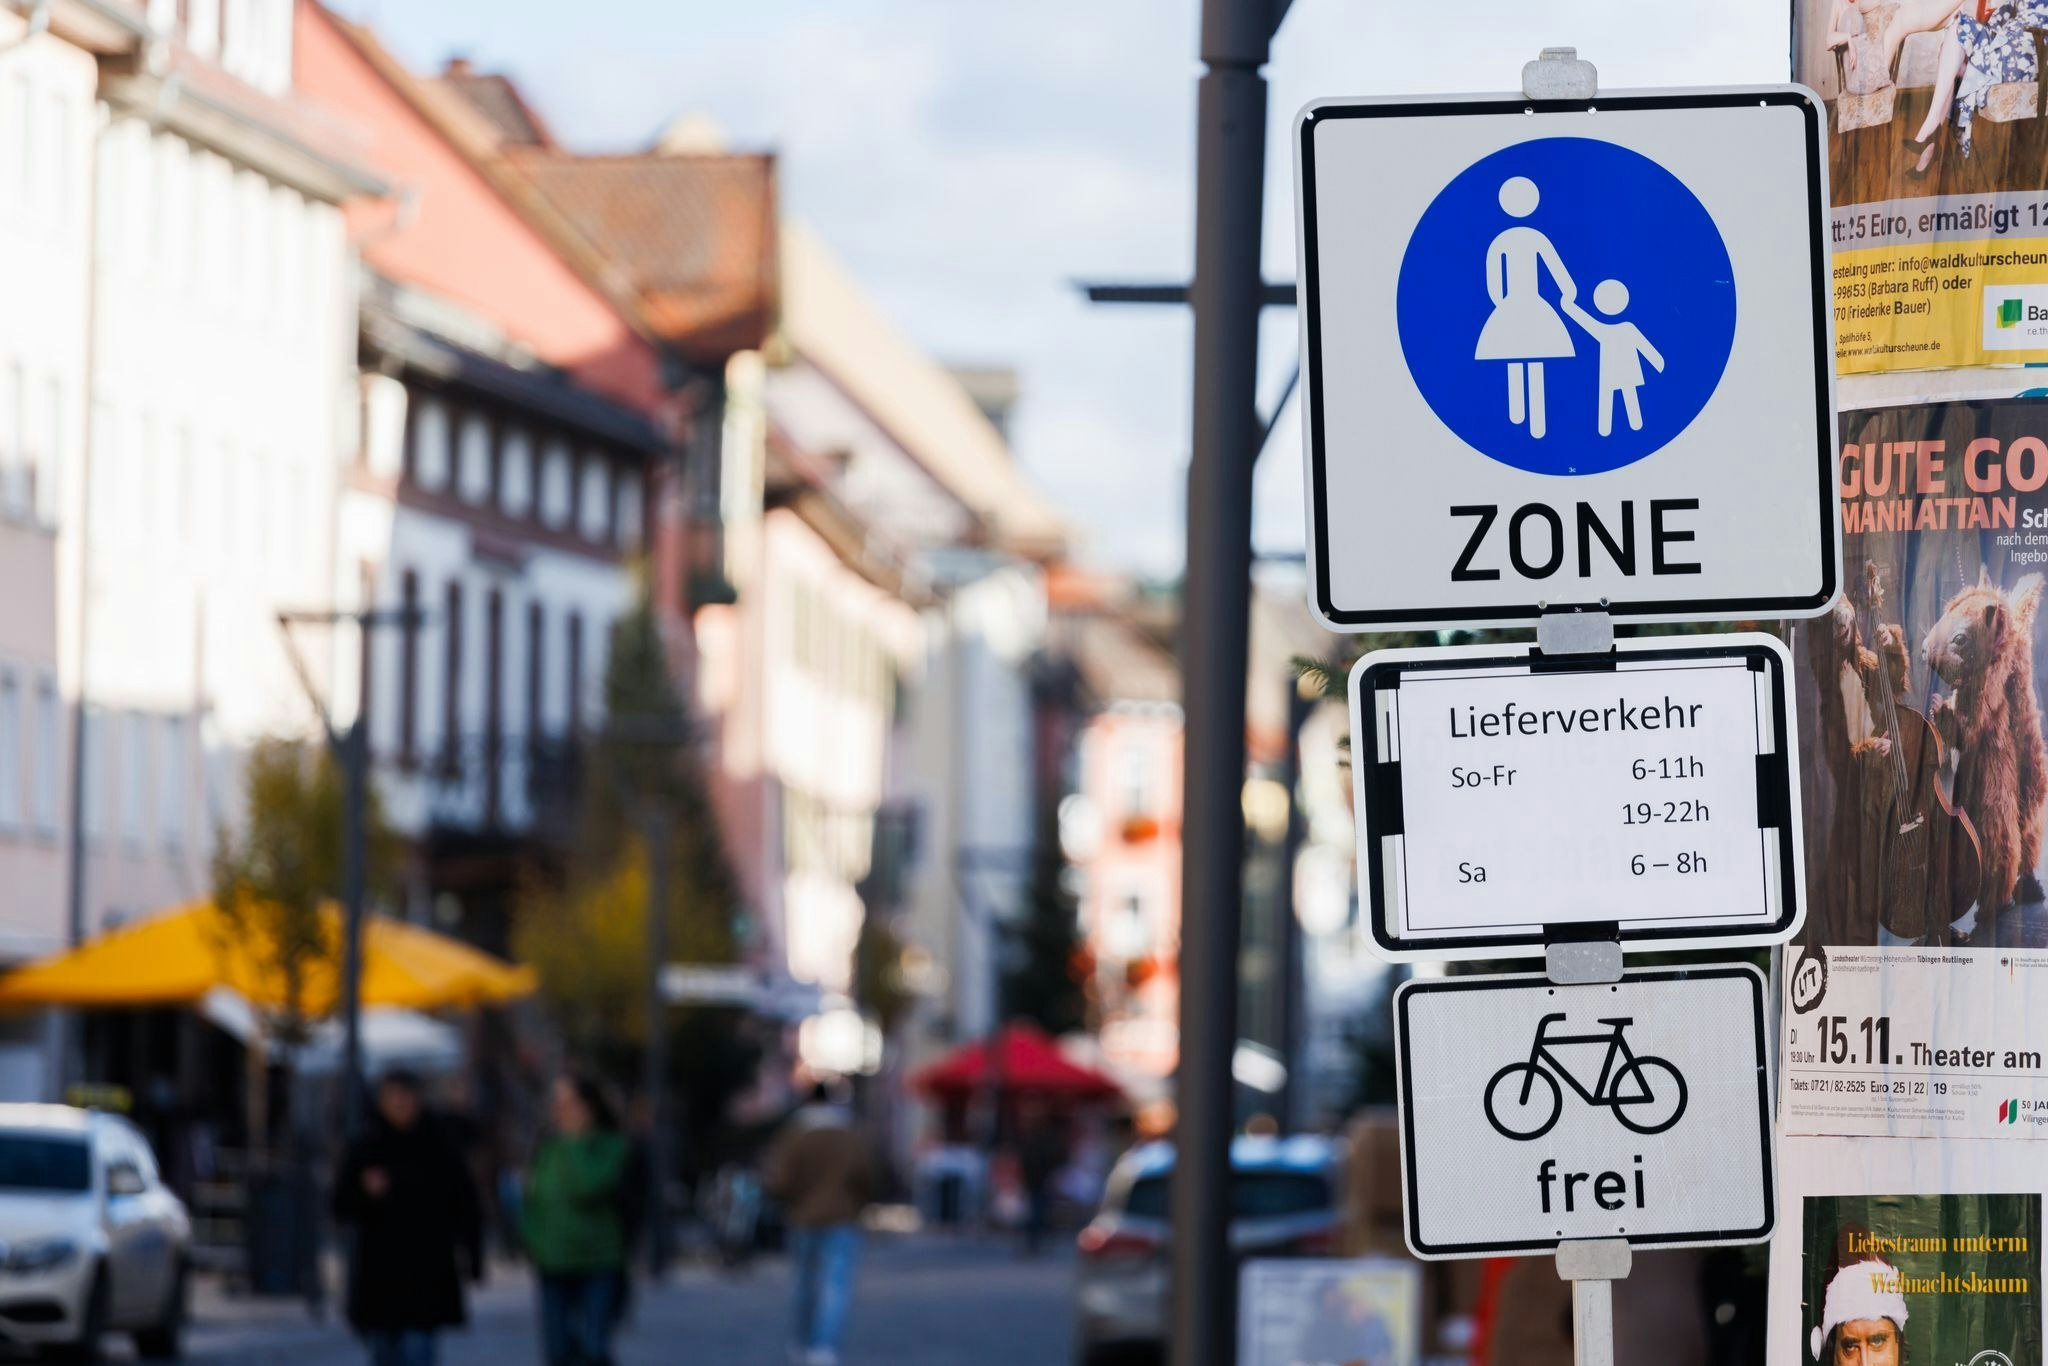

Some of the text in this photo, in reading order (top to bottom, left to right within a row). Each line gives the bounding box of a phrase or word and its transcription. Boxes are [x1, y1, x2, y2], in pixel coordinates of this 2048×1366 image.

[1871, 213, 1912, 238] Euro,
[1918, 203, 2019, 234] ermäßigt
[1868, 280, 1909, 300] (Barbara
[1912, 276, 1939, 293] Ruff)
[1942, 275, 1972, 290] oder
[1894, 298, 1931, 315] Bauer)
[1840, 437, 2048, 498] GUTE GO
[1841, 496, 2016, 534] MANHATTAN
[1450, 497, 1702, 582] ZONE
[1996, 532, 2021, 546] nach
[2010, 549, 2048, 566] Ingebo
[1450, 695, 1703, 738] Lieferverkehr
[1451, 755, 1704, 788] So-Fr 6-11h
[1622, 799, 1709, 825] 19-22h
[1458, 862, 1486, 884] Sa
[1631, 854, 1646, 876] 6
[1676, 850, 1707, 874] 8h
[1817, 1015, 2041, 1069] 15.11. Theater am
[1870, 1080, 1890, 1094] Euro
[1892, 1081, 1906, 1094] 25
[1913, 1081, 1925, 1095] 22
[1933, 1082, 1947, 1095] 19
[2034, 1100, 2048, 1112] JA
[1536, 1154, 1645, 1214] frei
[1848, 1231, 2028, 1253] Liebestraum unterm
[1870, 1271, 2028, 1293] Weihnachtsbaum
